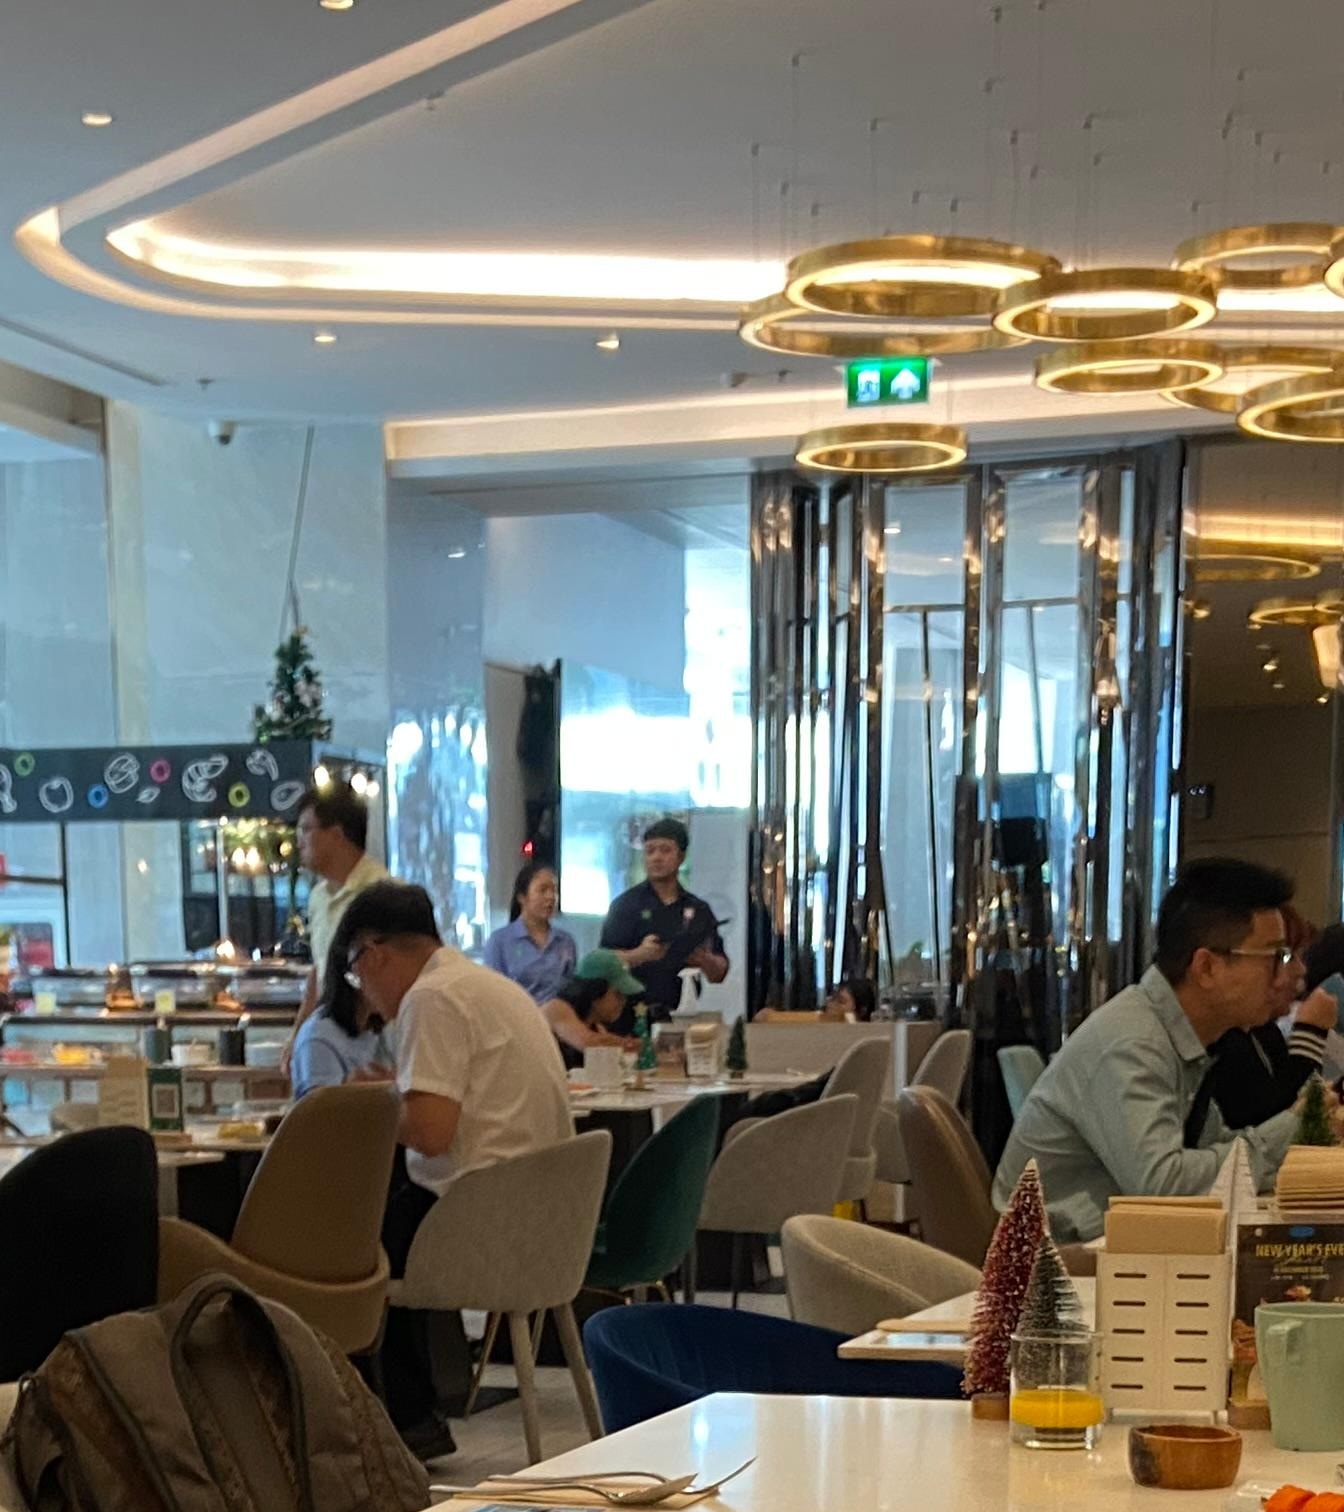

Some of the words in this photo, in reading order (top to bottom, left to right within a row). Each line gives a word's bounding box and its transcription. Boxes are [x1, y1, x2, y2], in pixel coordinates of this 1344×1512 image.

[1256, 1244, 1281, 1257] NEW
[1284, 1244, 1323, 1257] YEAR'S
[1324, 1243, 1344, 1256] EVE
